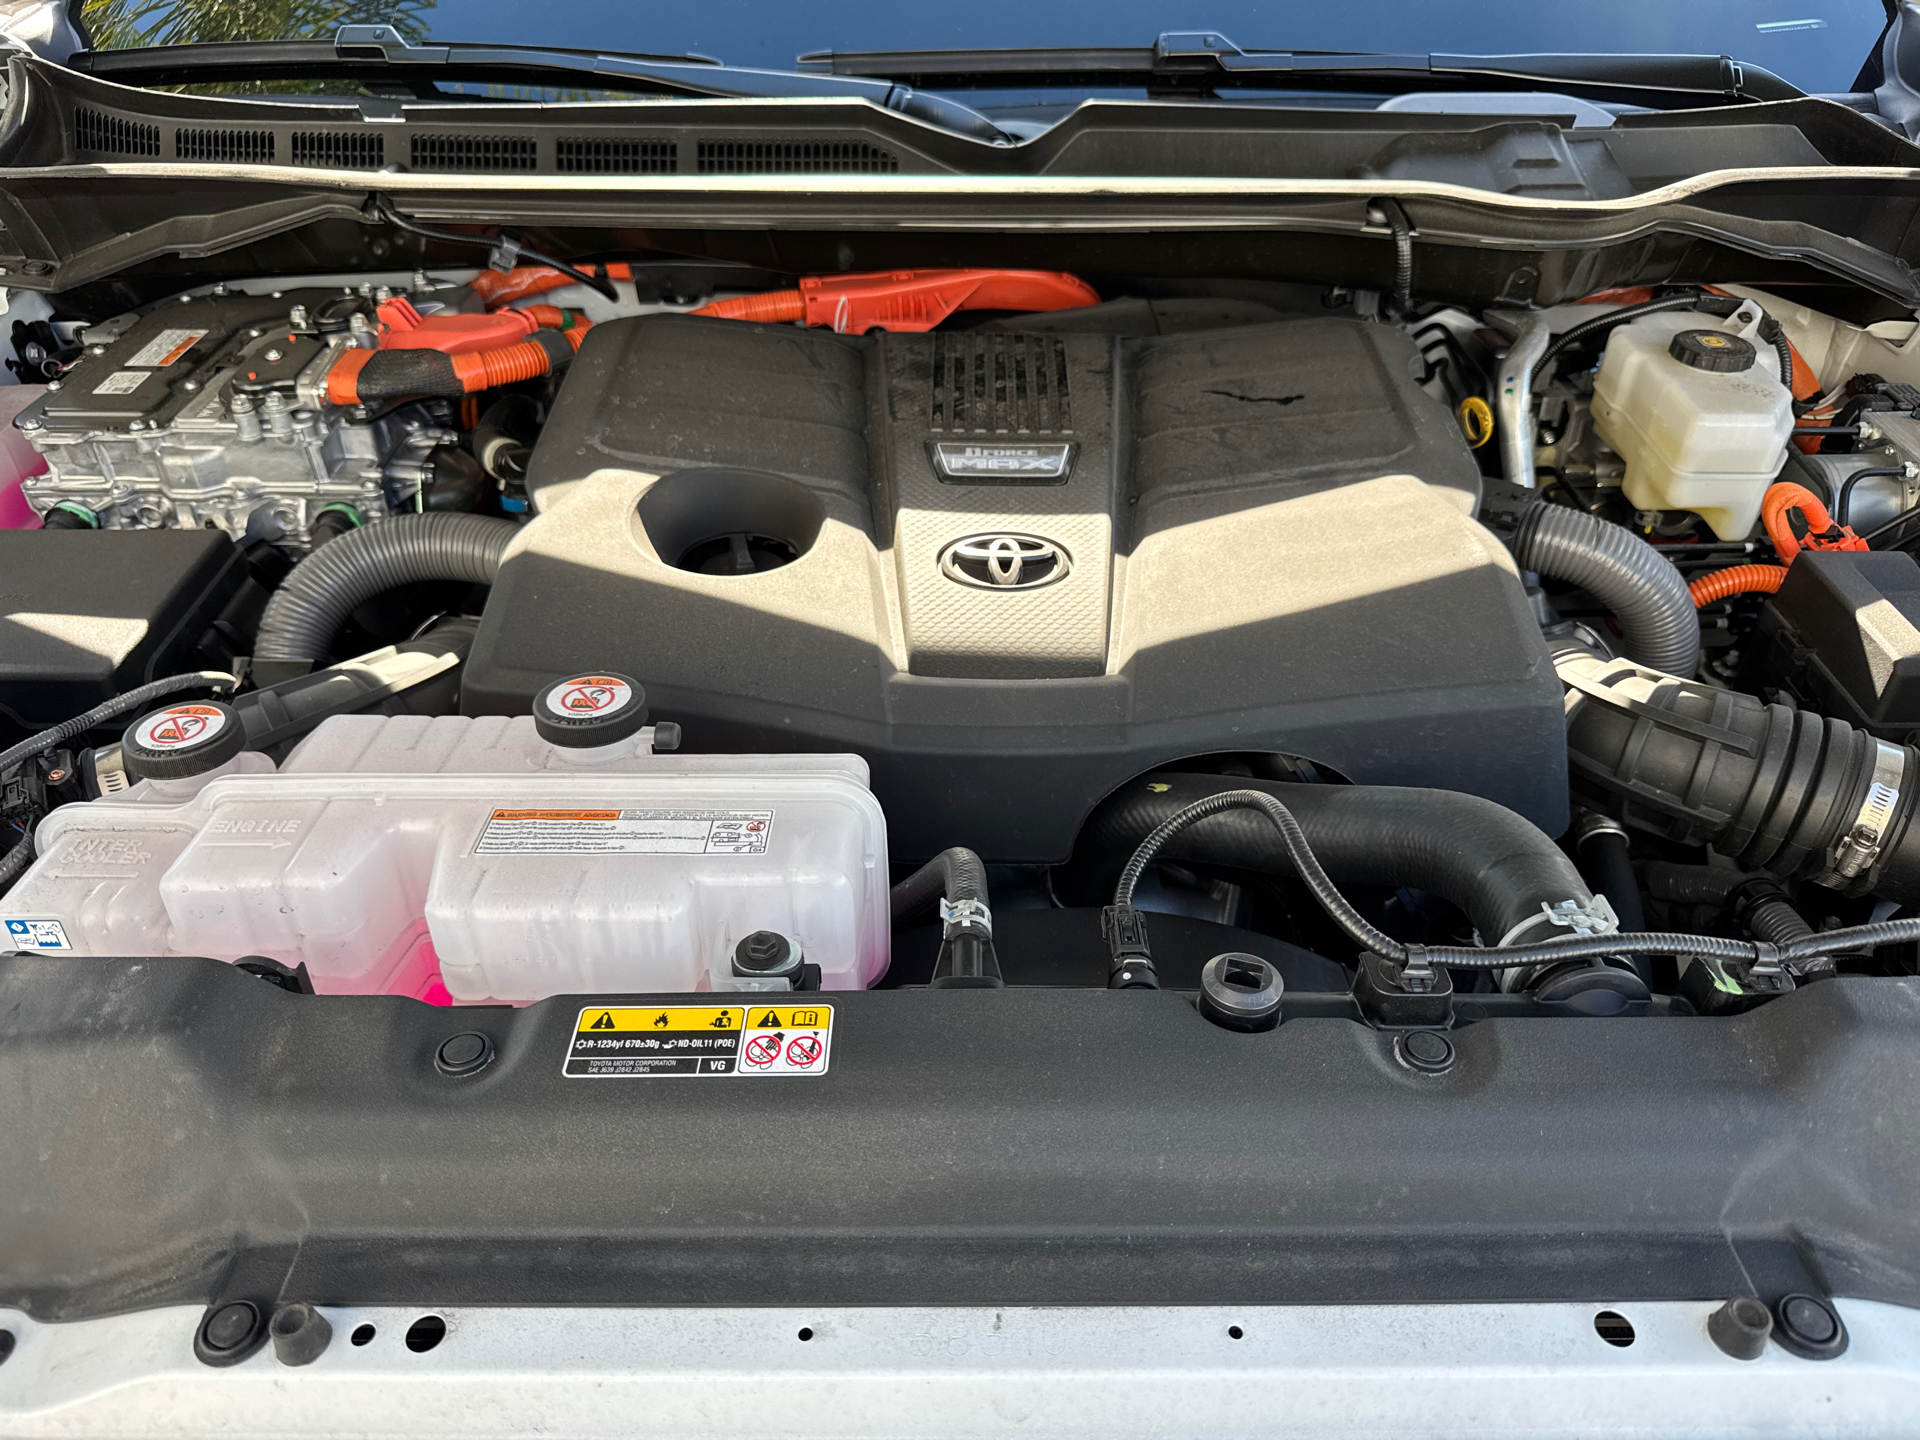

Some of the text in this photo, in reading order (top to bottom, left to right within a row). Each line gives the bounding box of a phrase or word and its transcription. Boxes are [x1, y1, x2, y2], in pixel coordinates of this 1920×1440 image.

[951, 458, 1056, 470] MAX
[210, 819, 302, 834] ENGINE
[69, 838, 144, 852] INTER
[59, 851, 151, 865] COOLER
[586, 1038, 736, 1050] R-1234yf 670±30g ND-OIL11 (POE)
[710, 1061, 726, 1071] VG
